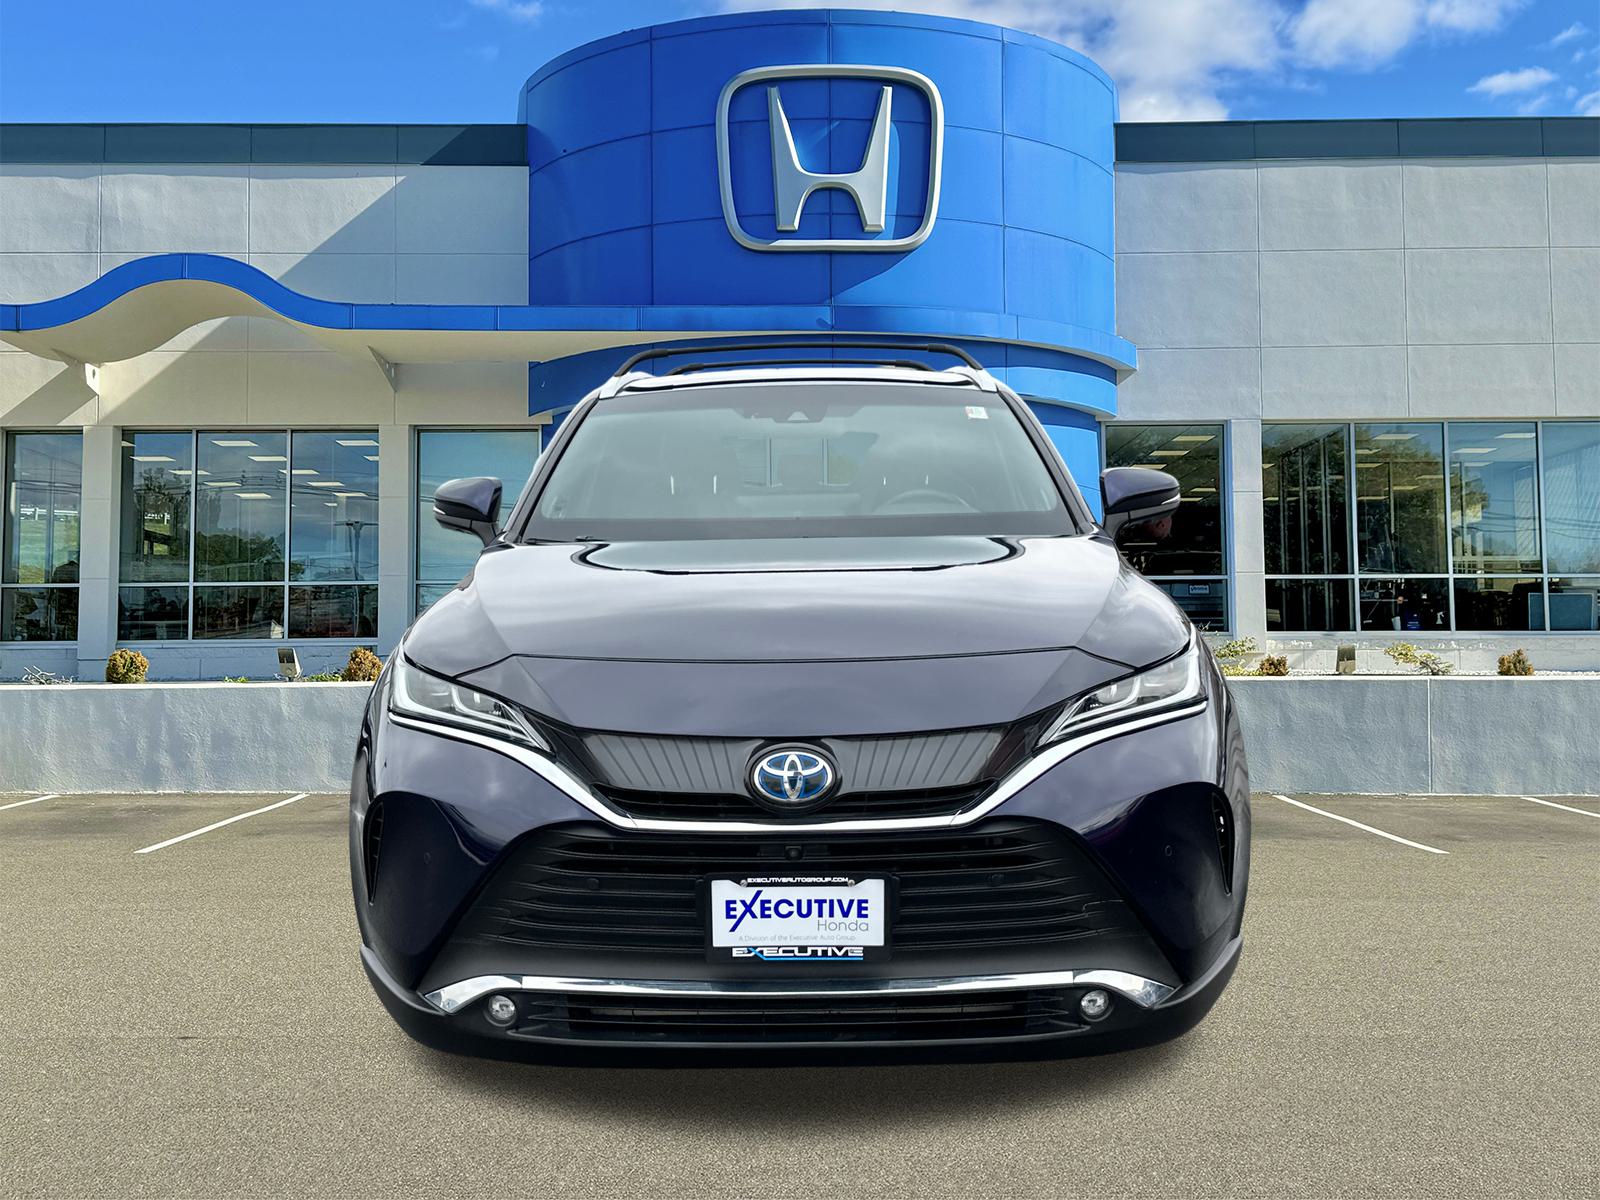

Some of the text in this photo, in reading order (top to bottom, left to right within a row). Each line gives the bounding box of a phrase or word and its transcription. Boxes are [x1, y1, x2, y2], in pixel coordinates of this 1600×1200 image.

[725, 890, 869, 932] EXECUTIVE
[817, 919, 869, 932] Honda
[732, 947, 864, 960] EXECUTIVE
